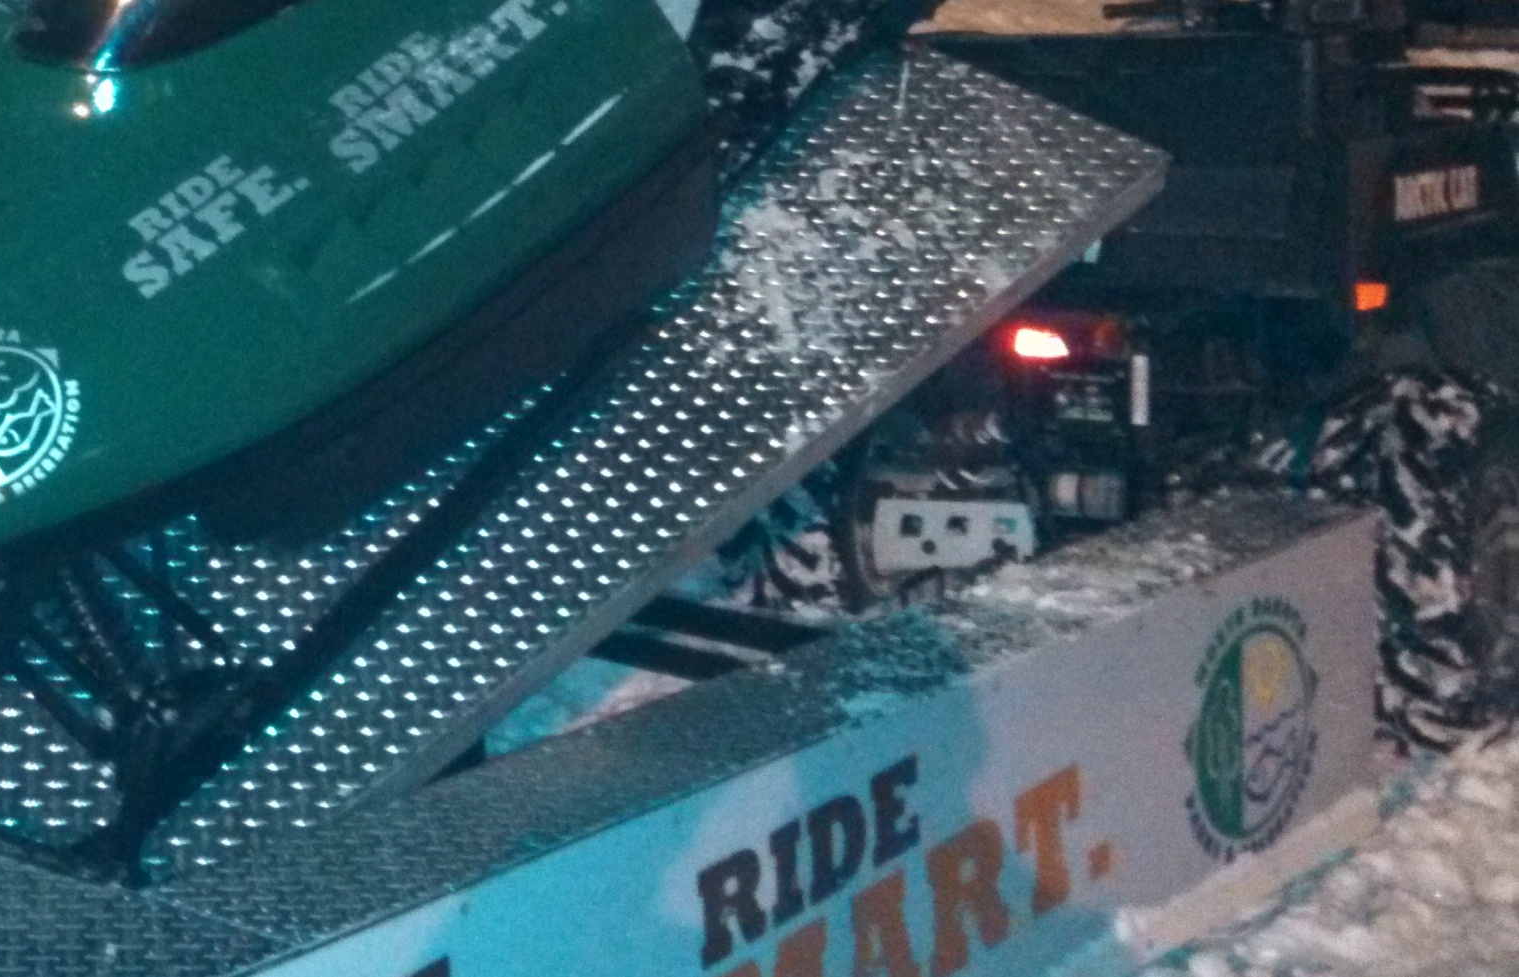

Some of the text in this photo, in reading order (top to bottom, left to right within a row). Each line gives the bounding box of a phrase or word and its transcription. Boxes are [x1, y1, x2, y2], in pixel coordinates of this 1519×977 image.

[329, 30, 443, 120] RIDE
[122, 165, 312, 299] SAFE.
[127, 154, 246, 242] RIDE
[11, 379, 82, 497] RECREATION
[697, 753, 921, 971] RIDE
